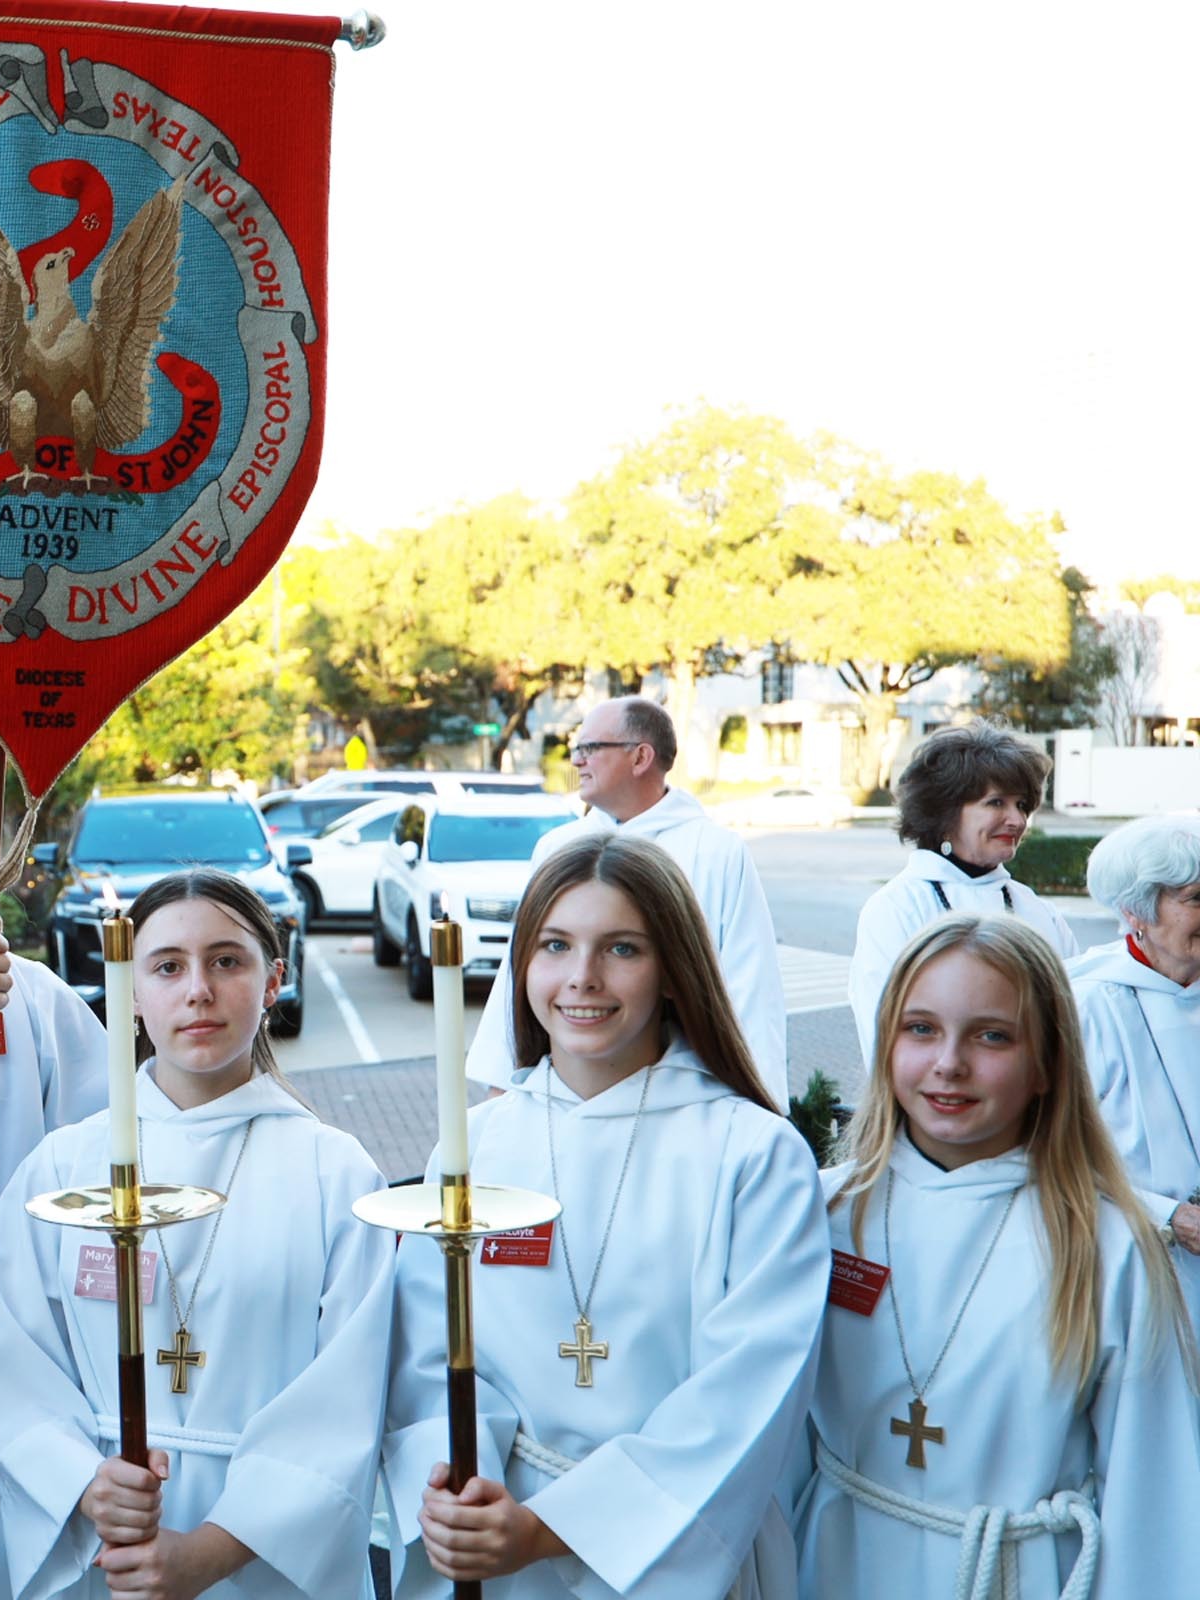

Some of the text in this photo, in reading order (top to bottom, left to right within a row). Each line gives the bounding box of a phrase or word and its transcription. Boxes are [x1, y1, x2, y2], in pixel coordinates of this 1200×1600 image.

[112, 91, 202, 162] TEXAS
[193, 166, 285, 308] HOUSTON
[35, 443, 75, 472] OF
[117, 461, 154, 490] ST
[161, 399, 216, 482] JOHN
[227, 341, 291, 513] EPISCOPAL
[21, 534, 80, 560] 1939
[66, 521, 219, 624] DIVINE
[15, 668, 87, 687] DIOCESE
[40, 690, 63, 708] OF
[22, 711, 77, 729] TEXAS
[85, 1249, 113, 1265] Mary
